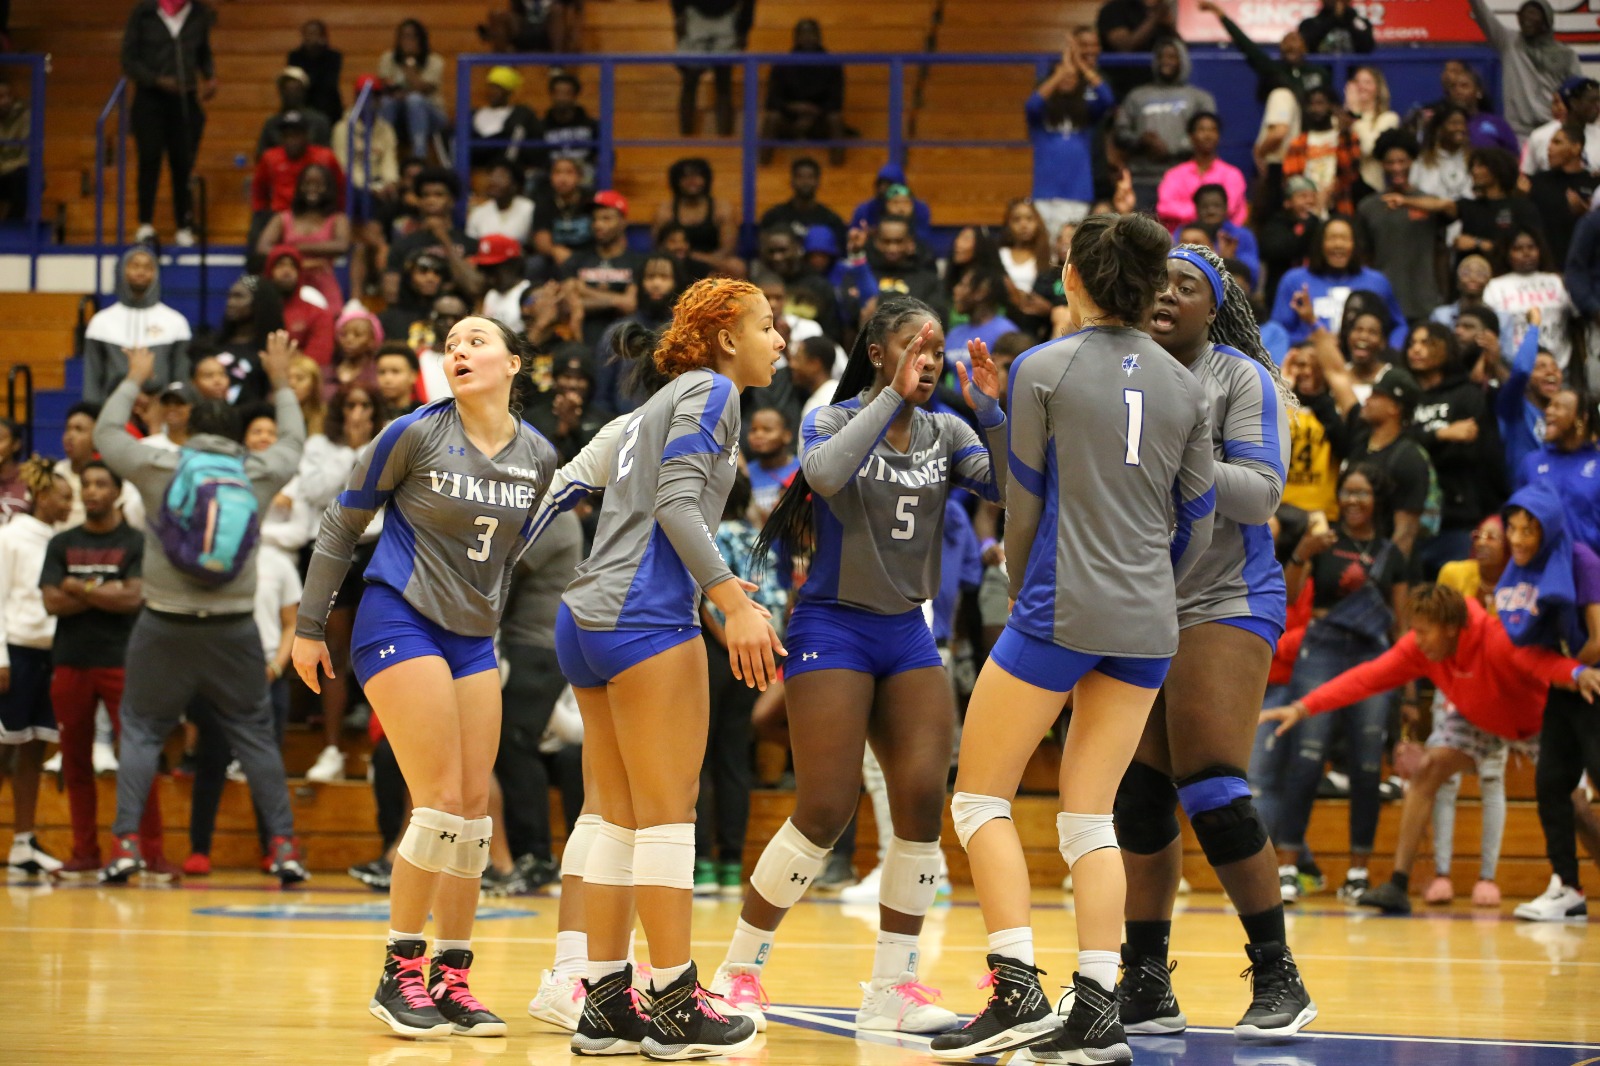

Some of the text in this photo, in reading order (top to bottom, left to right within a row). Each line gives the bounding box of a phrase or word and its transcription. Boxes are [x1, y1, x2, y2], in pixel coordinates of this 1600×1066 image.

[616, 414, 645, 484] 2
[1123, 388, 1144, 467] 1
[429, 470, 536, 509] VIKINGS
[466, 515, 499, 562] 3
[890, 495, 920, 540] 5
